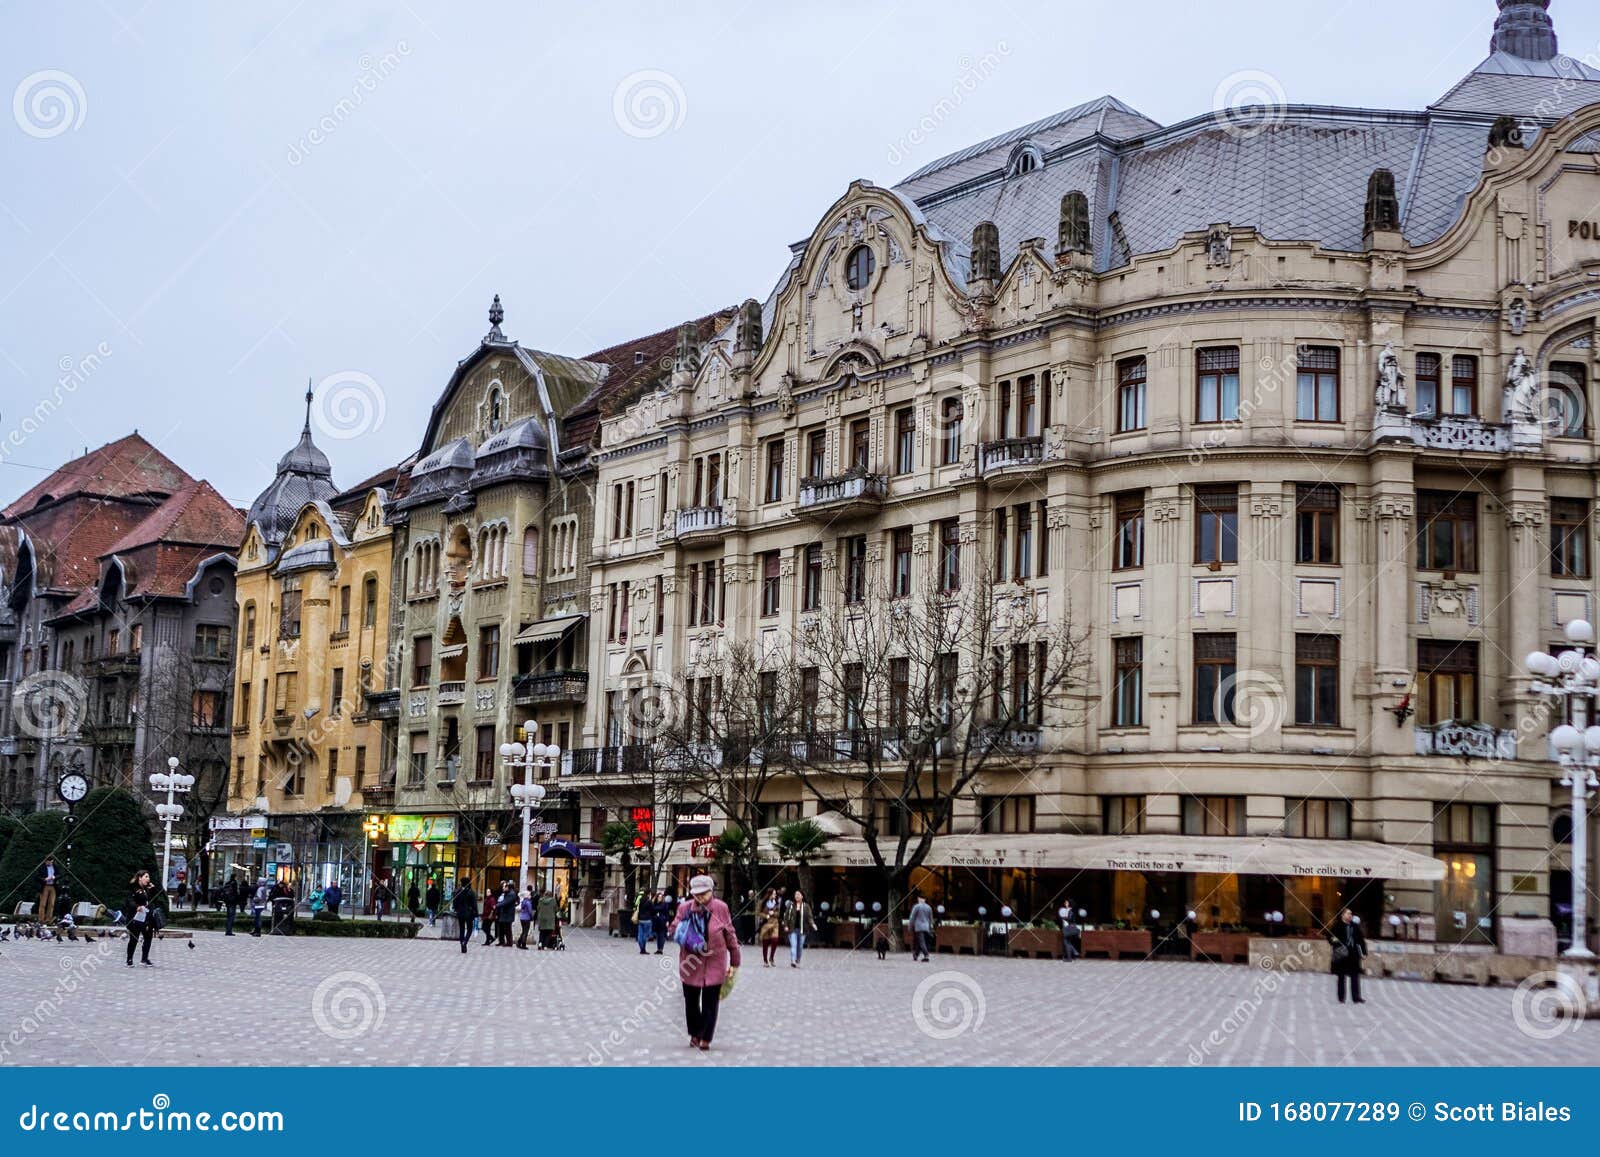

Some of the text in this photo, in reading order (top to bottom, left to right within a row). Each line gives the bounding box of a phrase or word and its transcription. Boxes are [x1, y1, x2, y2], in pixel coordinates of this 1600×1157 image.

[951, 856, 965, 864] That
[966, 857, 980, 865] calls
[982, 857, 991, 865] for
[1106, 859, 1127, 868] That
[1130, 860, 1150, 869] calls
[1153, 861, 1165, 869] for
[1292, 865, 1313, 874] That
[1316, 866, 1337, 875] calls
[1340, 867, 1352, 875] for
